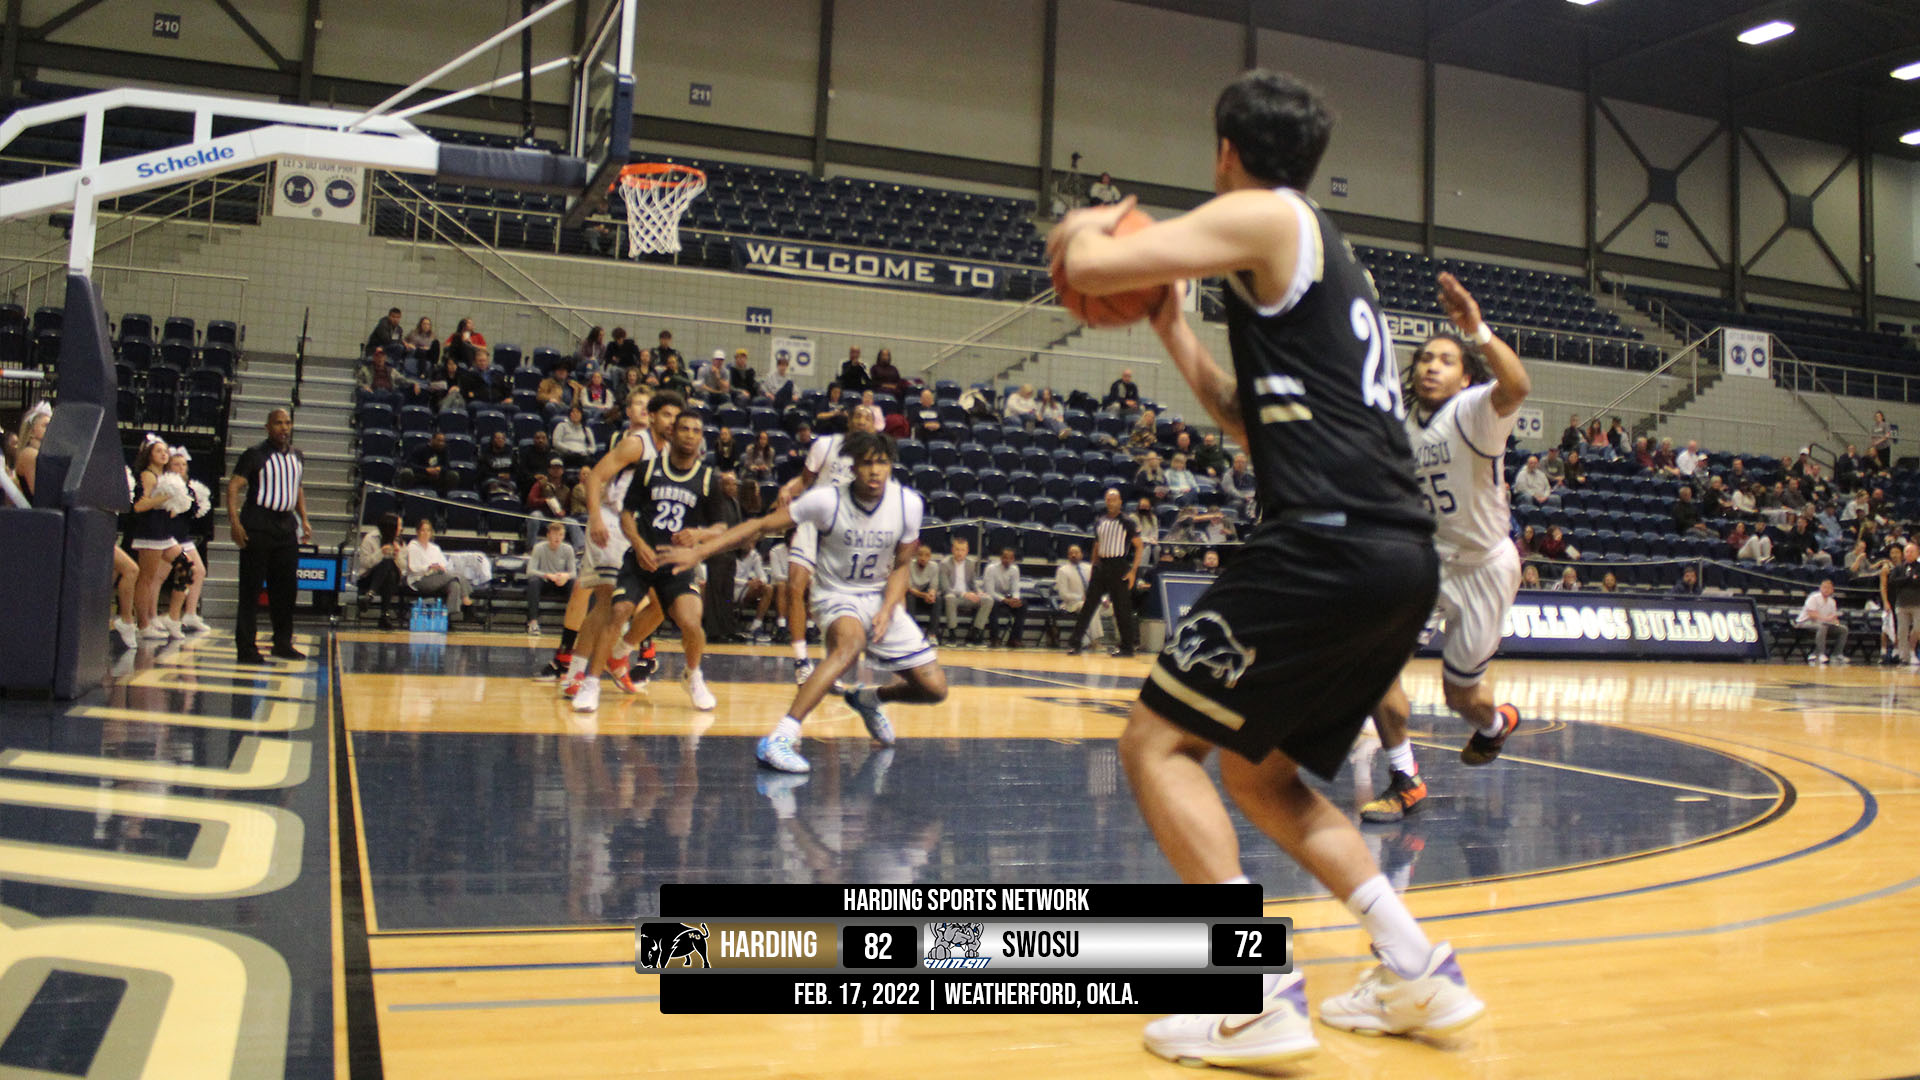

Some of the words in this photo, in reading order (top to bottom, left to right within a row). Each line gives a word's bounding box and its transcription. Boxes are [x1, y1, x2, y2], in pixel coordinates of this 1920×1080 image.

[154, 19, 180, 33] 210
[691, 88, 710, 101] 211
[136, 146, 235, 179] Schelde
[745, 242, 936, 283] WELCOME
[949, 264, 995, 289] TO
[652, 500, 686, 533] 23
[843, 529, 895, 549] SWOSU
[845, 553, 879, 580] 12
[1630, 609, 1758, 643] BULLDOGS
